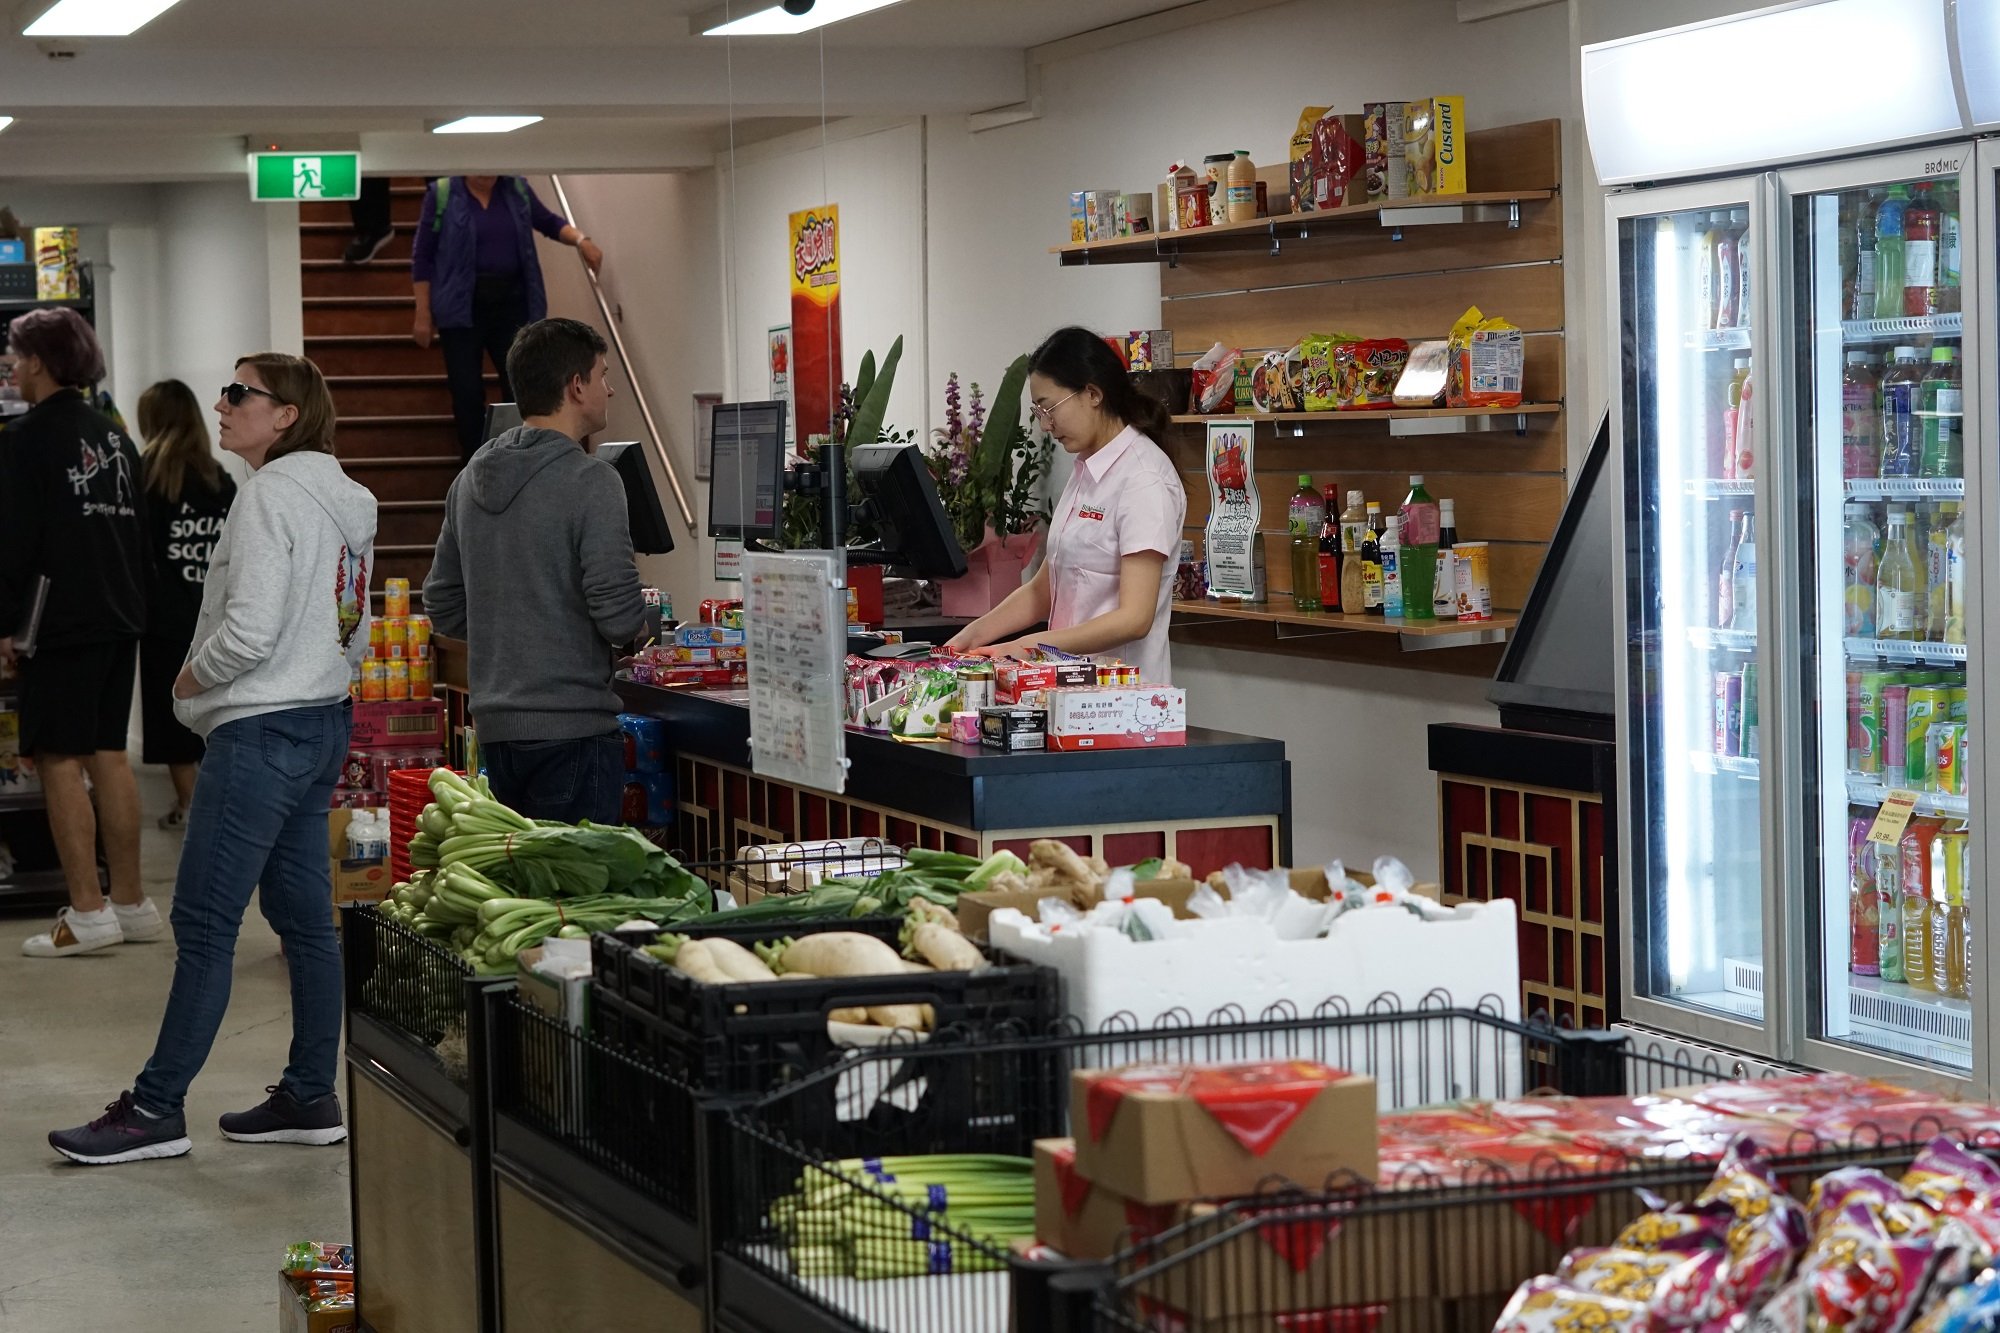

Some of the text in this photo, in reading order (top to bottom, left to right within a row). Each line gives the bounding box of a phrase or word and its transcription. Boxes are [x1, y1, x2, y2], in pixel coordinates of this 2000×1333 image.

[1438, 103, 1454, 165] Custard
[1925, 158, 1959, 174] BROMIC
[1235, 376, 1252, 387] GOLDEN
[170, 517, 224, 538] SOCIA
[167, 542, 213, 563] SOCI
[1069, 710, 1124, 719] HELLO KITTY
[1873, 832, 1890, 841] $0.99
